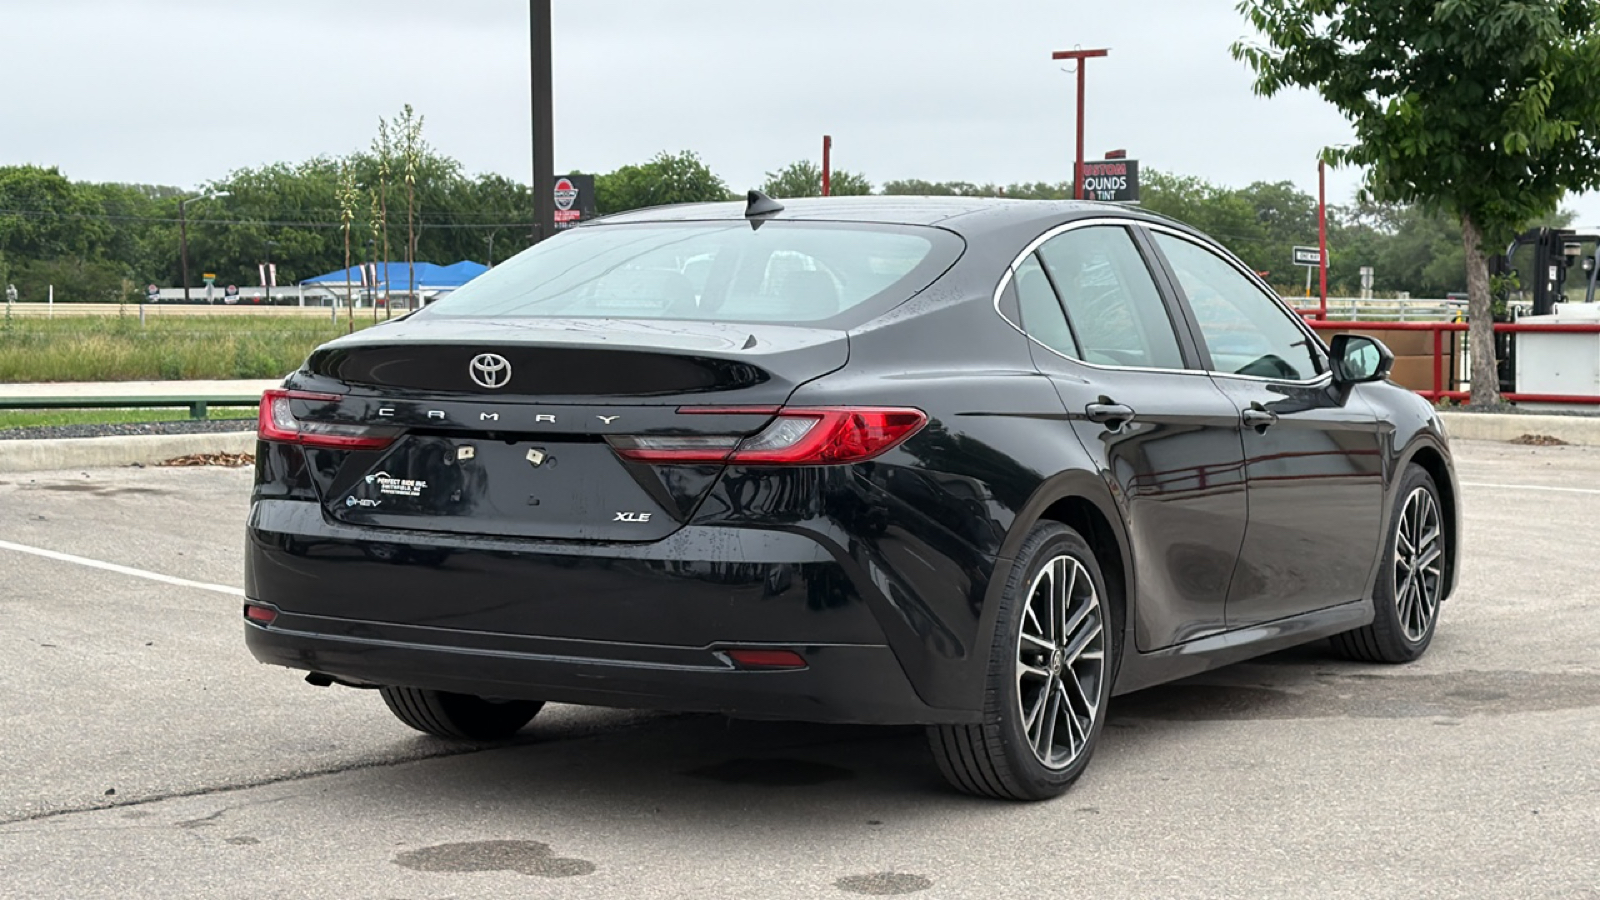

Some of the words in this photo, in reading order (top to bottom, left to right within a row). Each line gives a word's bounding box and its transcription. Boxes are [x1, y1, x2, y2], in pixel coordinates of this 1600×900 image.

[1083, 164, 1127, 176] USTOM
[1083, 176, 1127, 190] OUNDS
[1097, 190, 1116, 200] TINT
[379, 408, 620, 424] CAMRY
[612, 511, 652, 522] XLE
